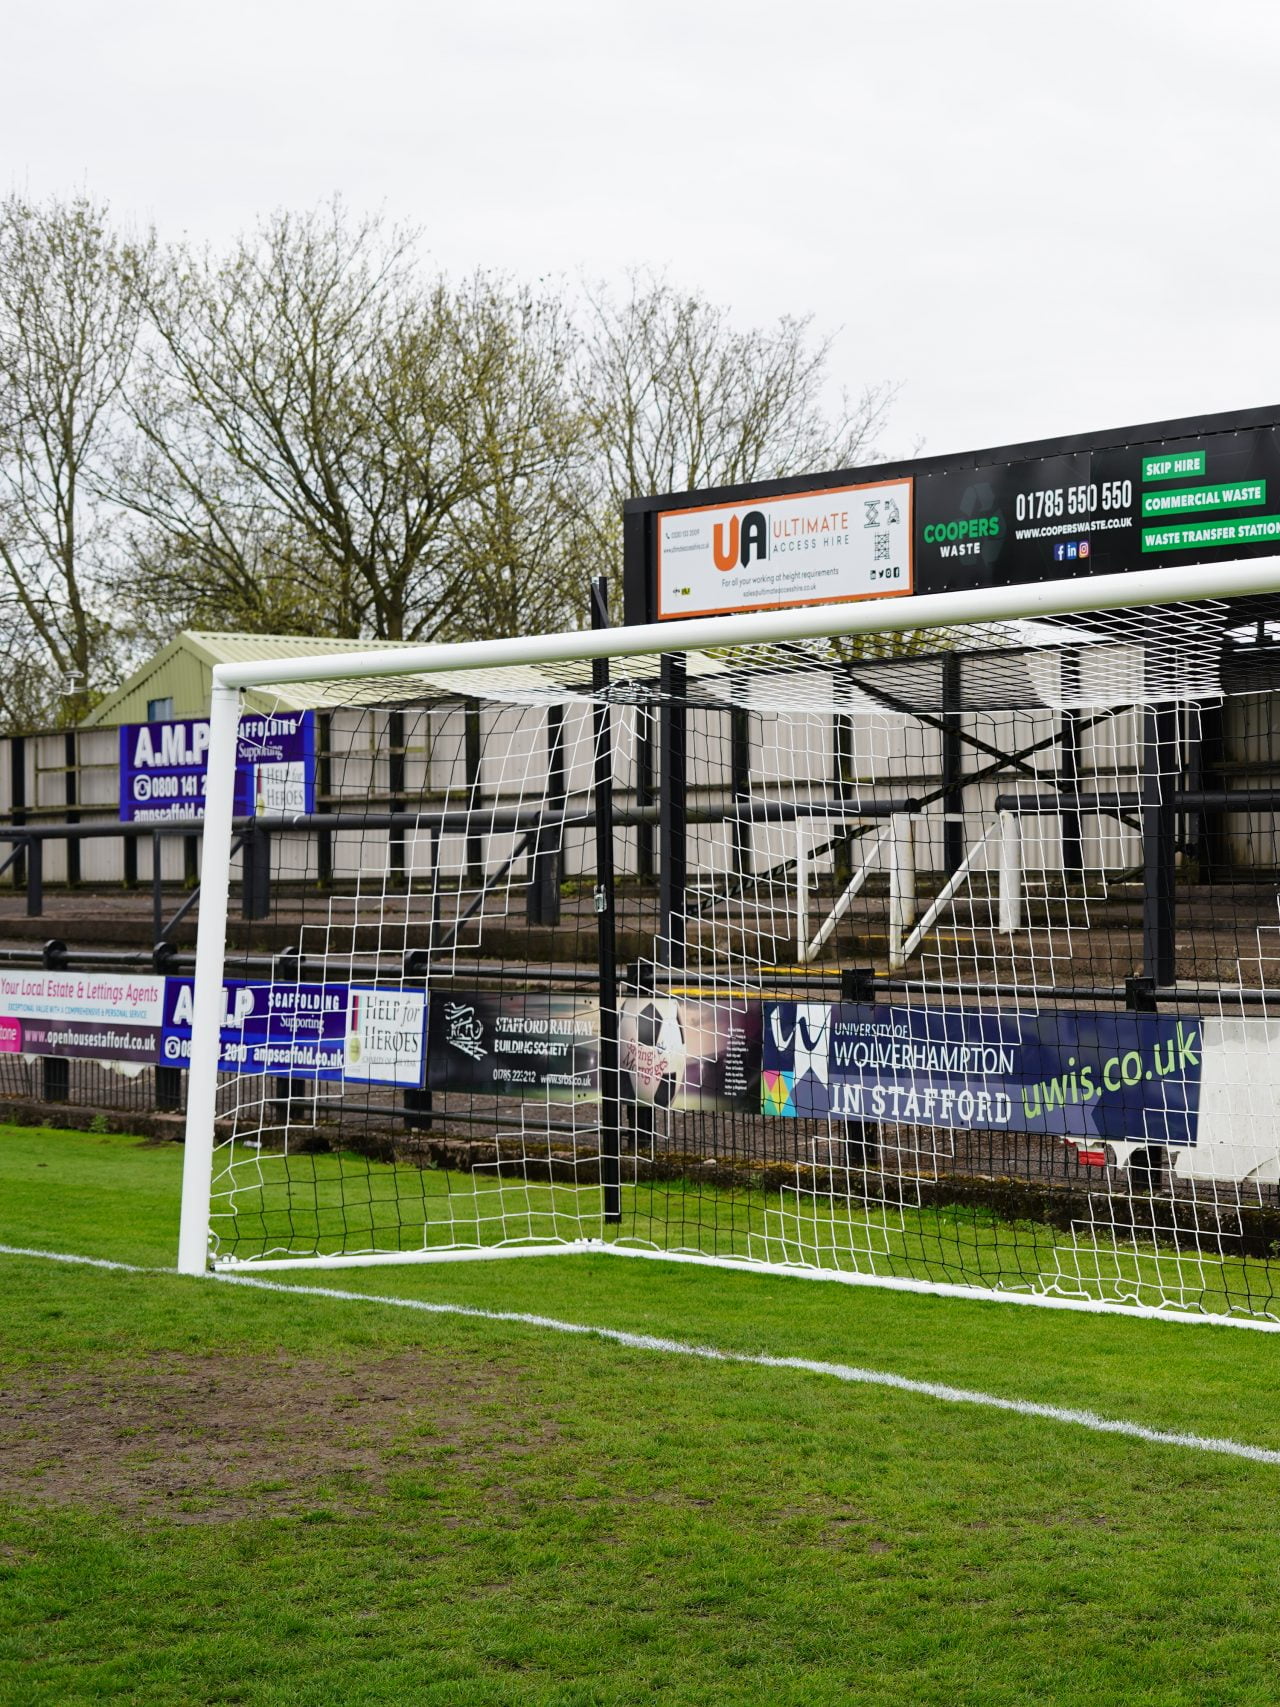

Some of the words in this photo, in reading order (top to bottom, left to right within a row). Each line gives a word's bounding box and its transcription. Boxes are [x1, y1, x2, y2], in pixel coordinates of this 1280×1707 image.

[1146, 461, 1171, 476] SKIP
[1174, 458, 1200, 473] HIRE
[1016, 488, 1064, 521] 01785
[1068, 483, 1098, 515] 550
[1102, 479, 1132, 510] 550
[1145, 491, 1220, 511] COMMERCIAL
[1222, 486, 1261, 502] WASTE
[774, 511, 849, 538] ULTIMATE
[924, 516, 999, 543] COOPERS
[1015, 517, 1133, 540] WWW.COOPERSWASTE.CO.UK
[714, 511, 766, 571] UA
[773, 536, 817, 552] ACCESS
[824, 534, 849, 548] HIRE
[1145, 532, 1180, 546] WASTE
[1182, 526, 1236, 543] TRANSFER
[940, 542, 980, 557] WASTE
[722, 579, 731, 588] For
[740, 577, 751, 588] your
[753, 574, 774, 585] working
[783, 572, 800, 583] height
[801, 568, 839, 580] requirements
[237, 718, 296, 738] AFFOLDING
[238, 742, 283, 762] Supporting
[152, 776, 178, 797] 0800
[181, 775, 197, 796] 141
[267, 788, 303, 806] HEROES
[1, 978, 19, 995] Your
[21, 980, 44, 996] Local
[47, 981, 74, 998] Estate
[77, 982, 83, 998] &
[87, 982, 123, 1005] Lettings
[125, 983, 158, 1006] Agents
[268, 992, 340, 1010] SCAFFOLDING
[366, 996, 400, 1021] HELP
[400, 1000, 420, 1027] for
[280, 1012, 325, 1034] Supporting
[495, 1016, 548, 1034] STAFFORD
[549, 1019, 594, 1036] RAILWAY
[835, 1022, 894, 1037] UNIVERSITY
[895, 1024, 909, 1037] OF
[24, 1029, 156, 1051] www.openhousestafford.co.uk
[364, 1025, 418, 1053] HEROES
[494, 1039, 533, 1054] BUILDING
[534, 1041, 569, 1057] SOCIETY
[253, 1045, 345, 1069] ampscaffold.co.uk
[834, 1040, 1015, 1076] WOLVERHAMPTON
[1022, 1020, 1199, 1119] uwis.co.uk
[830, 1082, 860, 1114] IN
[871, 1085, 1012, 1123] STAFFORD
